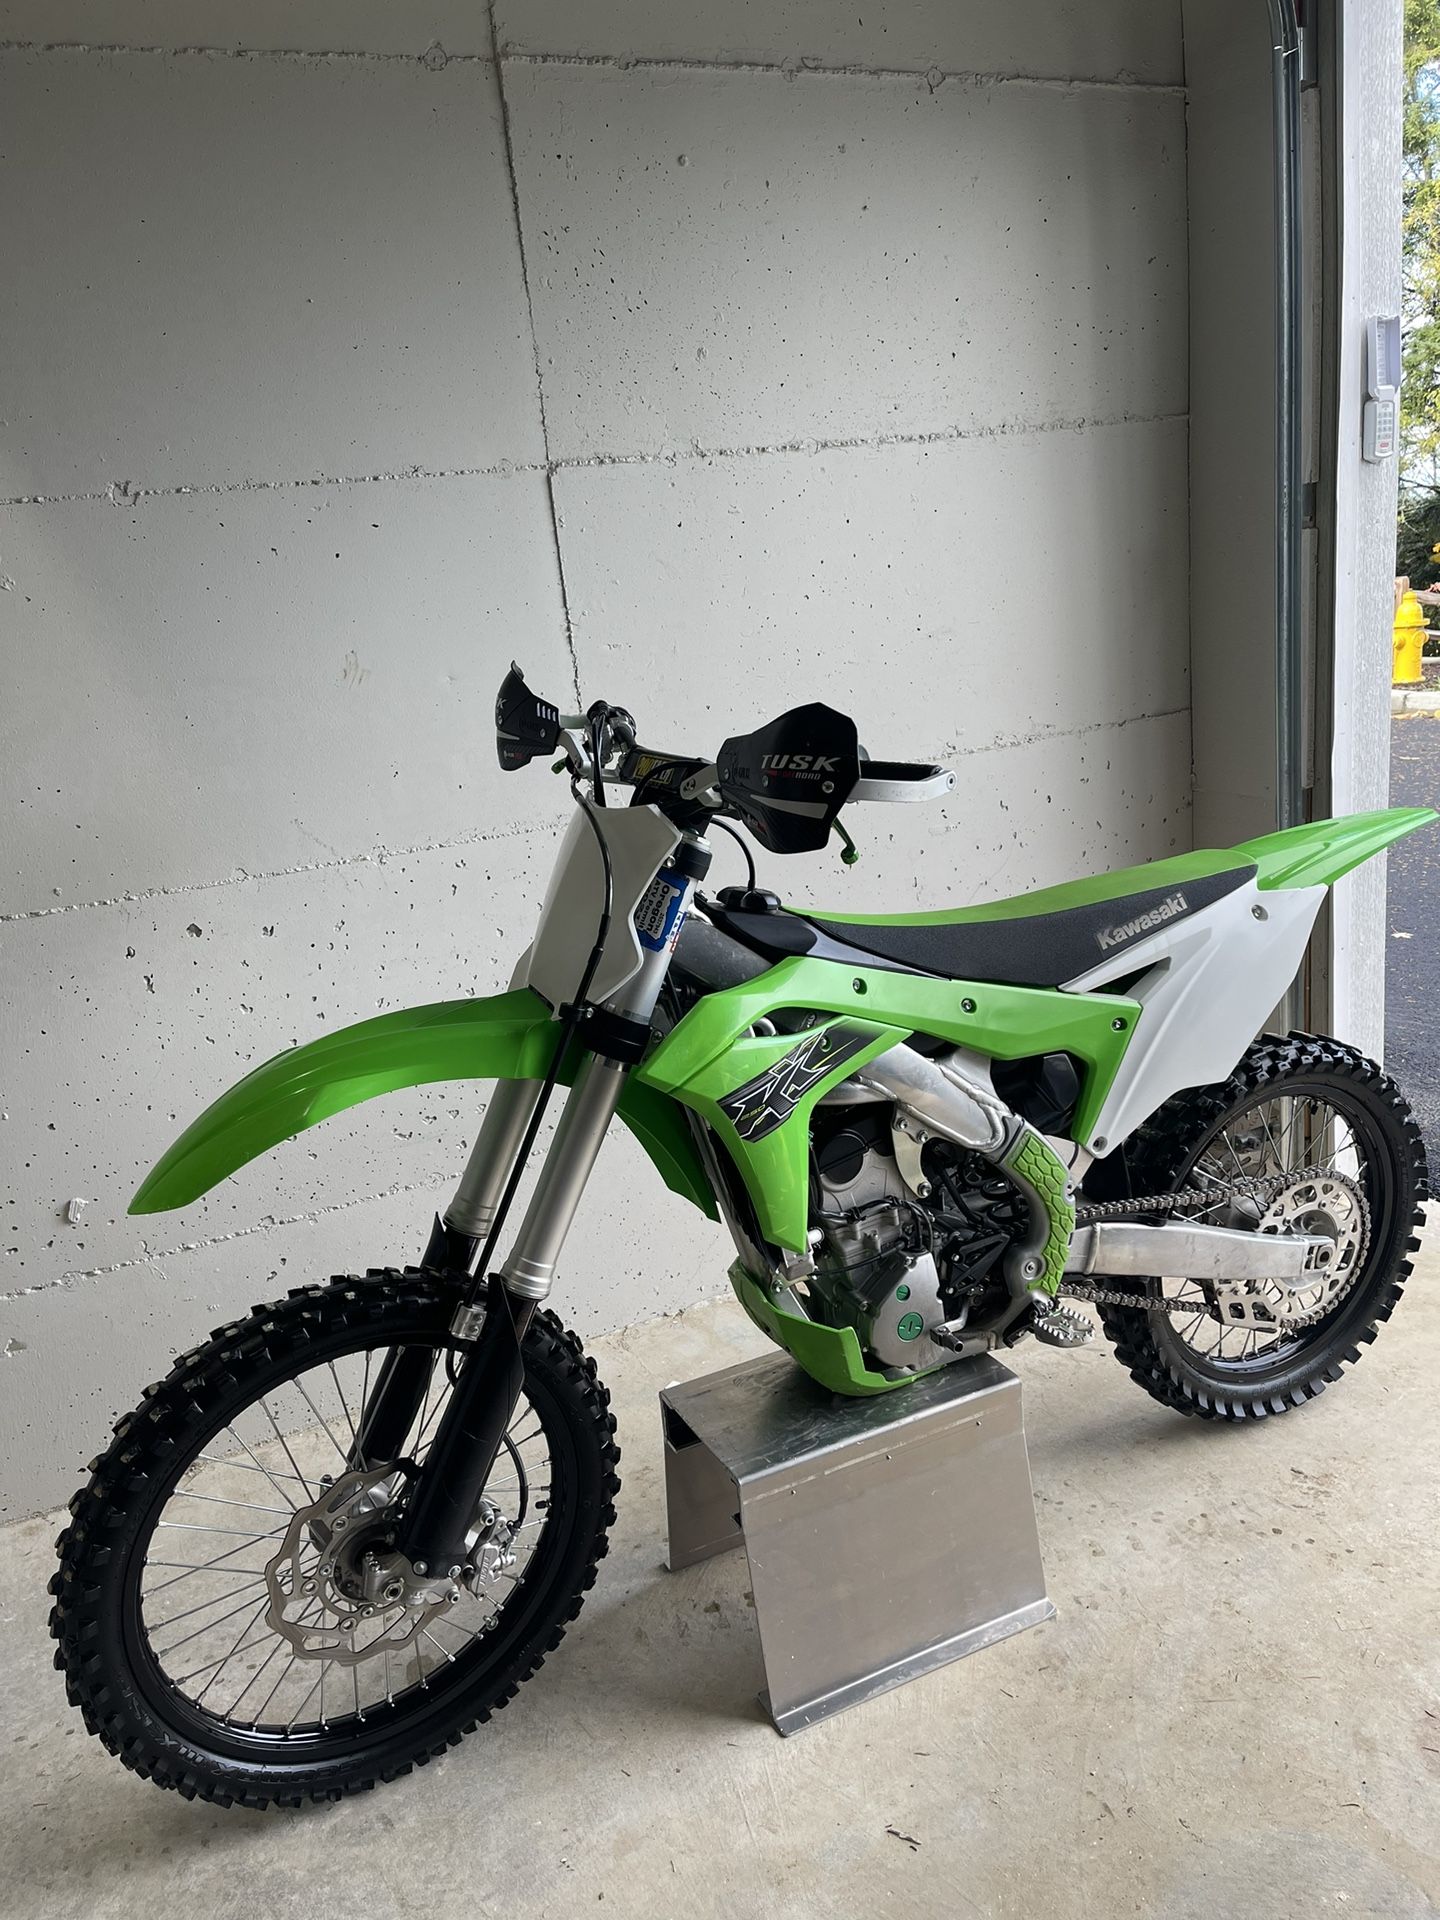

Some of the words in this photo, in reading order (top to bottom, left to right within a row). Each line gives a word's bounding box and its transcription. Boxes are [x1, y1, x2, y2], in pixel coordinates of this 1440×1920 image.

[761, 754, 841, 772] TUSK
[650, 880, 661, 898] ATV
[638, 899, 654, 929] Permit
[646, 884, 670, 932] Oregon
[1096, 893, 1188, 950] Kawasaki
[740, 1103, 766, 1122] 250
